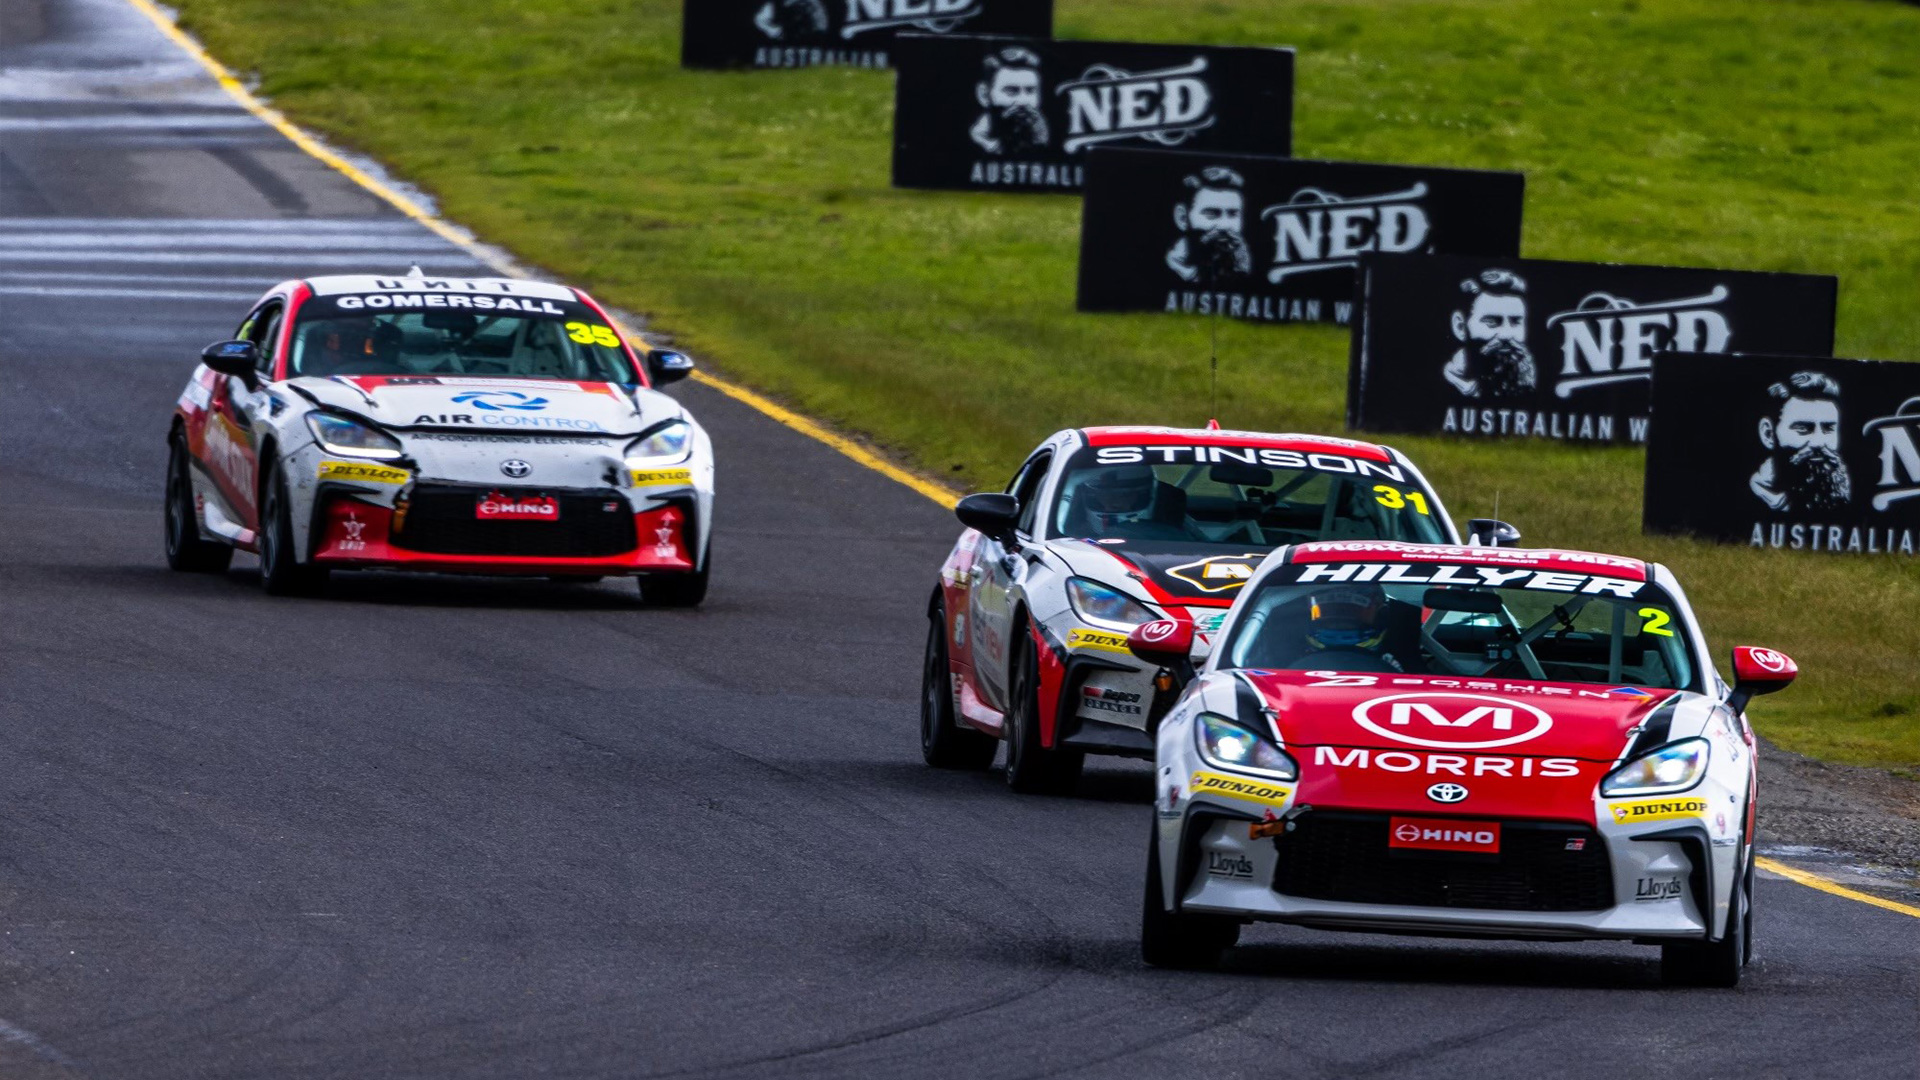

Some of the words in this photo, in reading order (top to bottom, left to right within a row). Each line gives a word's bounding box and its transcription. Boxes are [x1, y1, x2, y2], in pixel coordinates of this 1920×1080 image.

[1068, 77, 1211, 134] NED
[1273, 204, 1430, 263] NED
[336, 295, 564, 315] GOMERSALL
[1165, 290, 1321, 322] AUSTRALIAN
[565, 321, 620, 348] 35
[1559, 310, 1732, 375] NED
[413, 414, 474, 424] AIR
[481, 414, 610, 432] CONTROL
[1442, 406, 1613, 441] AUSTRALIAN
[332, 465, 405, 480] DUNLOP
[637, 471, 692, 482] DUNLOP
[1096, 445, 1406, 483] STINSON
[501, 504, 554, 514] HINO
[1373, 484, 1430, 515] 31
[1751, 521, 1920, 556] AUSTRALIA
[1471, 549, 1550, 560] PRE
[1558, 552, 1638, 570] MIX
[1296, 564, 1646, 598] HILLYER
[1638, 607, 1674, 637] 2
[1390, 703, 1513, 731] M
[1314, 746, 1580, 777] MORRIS
[1203, 777, 1287, 800] DUNLOP
[1631, 801, 1709, 816] DUNLOP
[1423, 828, 1495, 844] HINO
[1209, 852, 1254, 876] Lloyds
[1636, 876, 1682, 898] Lloyds
